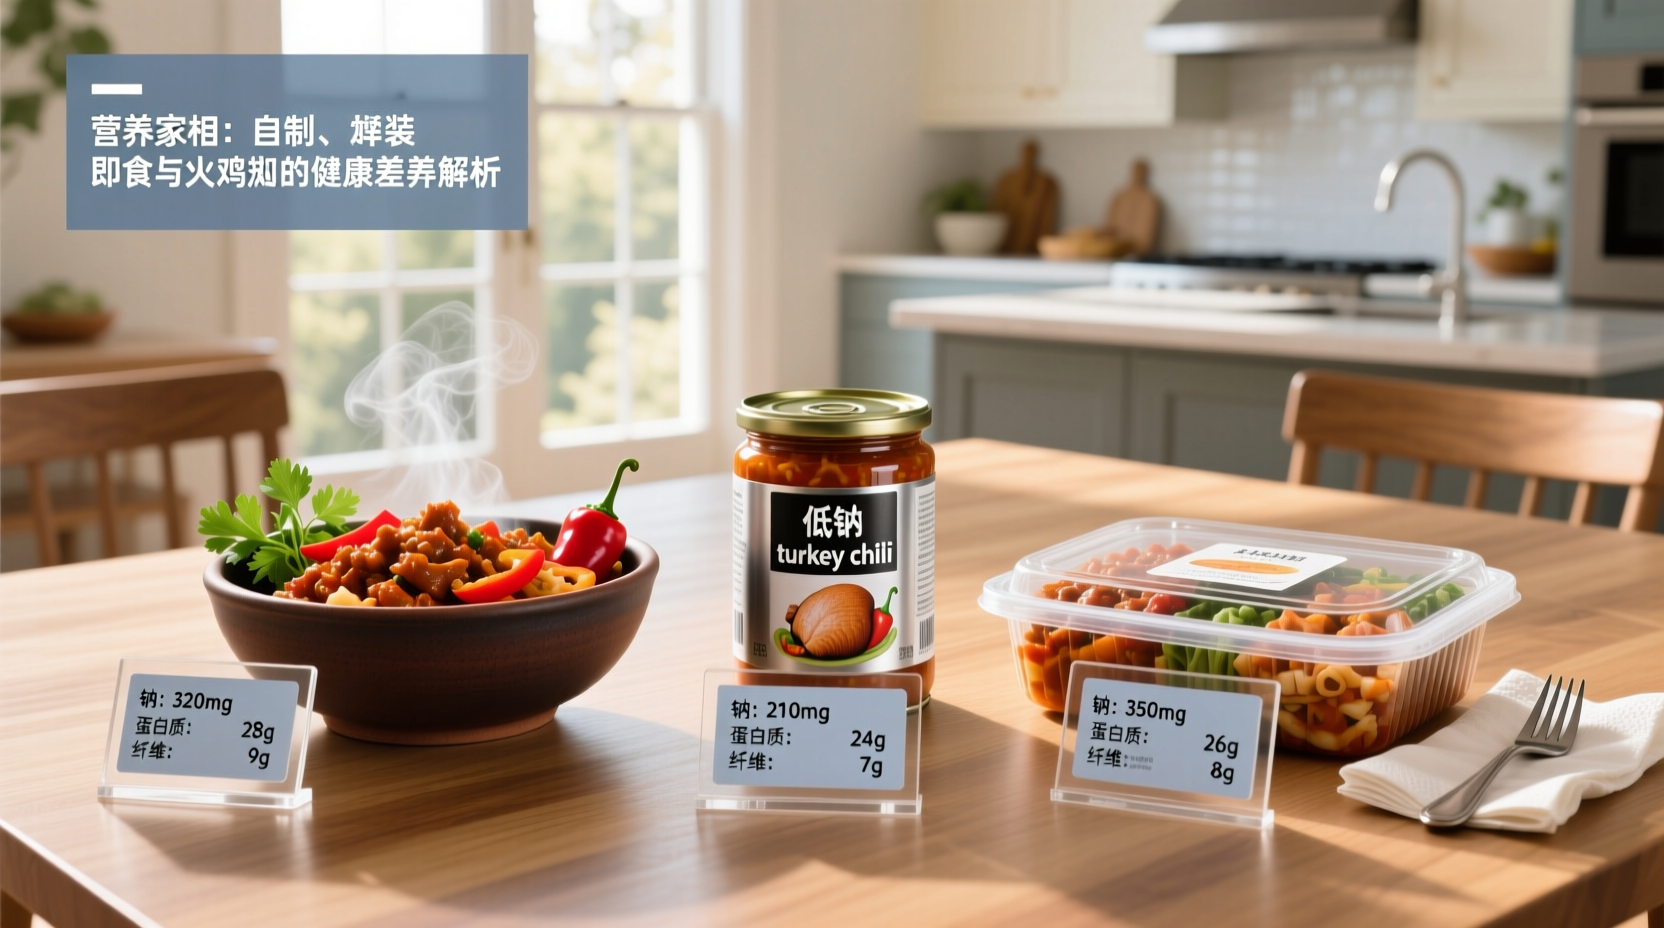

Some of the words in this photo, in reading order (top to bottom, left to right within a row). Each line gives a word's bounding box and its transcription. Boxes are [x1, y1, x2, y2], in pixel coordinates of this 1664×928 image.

[802, 503, 863, 539] 低钠
[776, 543, 845, 572] turkey
[849, 541, 893, 566] chili
[172, 691, 233, 717] 320mg
[766, 701, 830, 725] 210mg
[1124, 699, 1187, 726] 350mg
[240, 720, 275, 745] 28g
[850, 729, 886, 752] 24g
[249, 746, 271, 770] 9g
[1203, 733, 1239, 760] 26g
[859, 755, 883, 779] 7g
[1210, 761, 1235, 786] 8g
